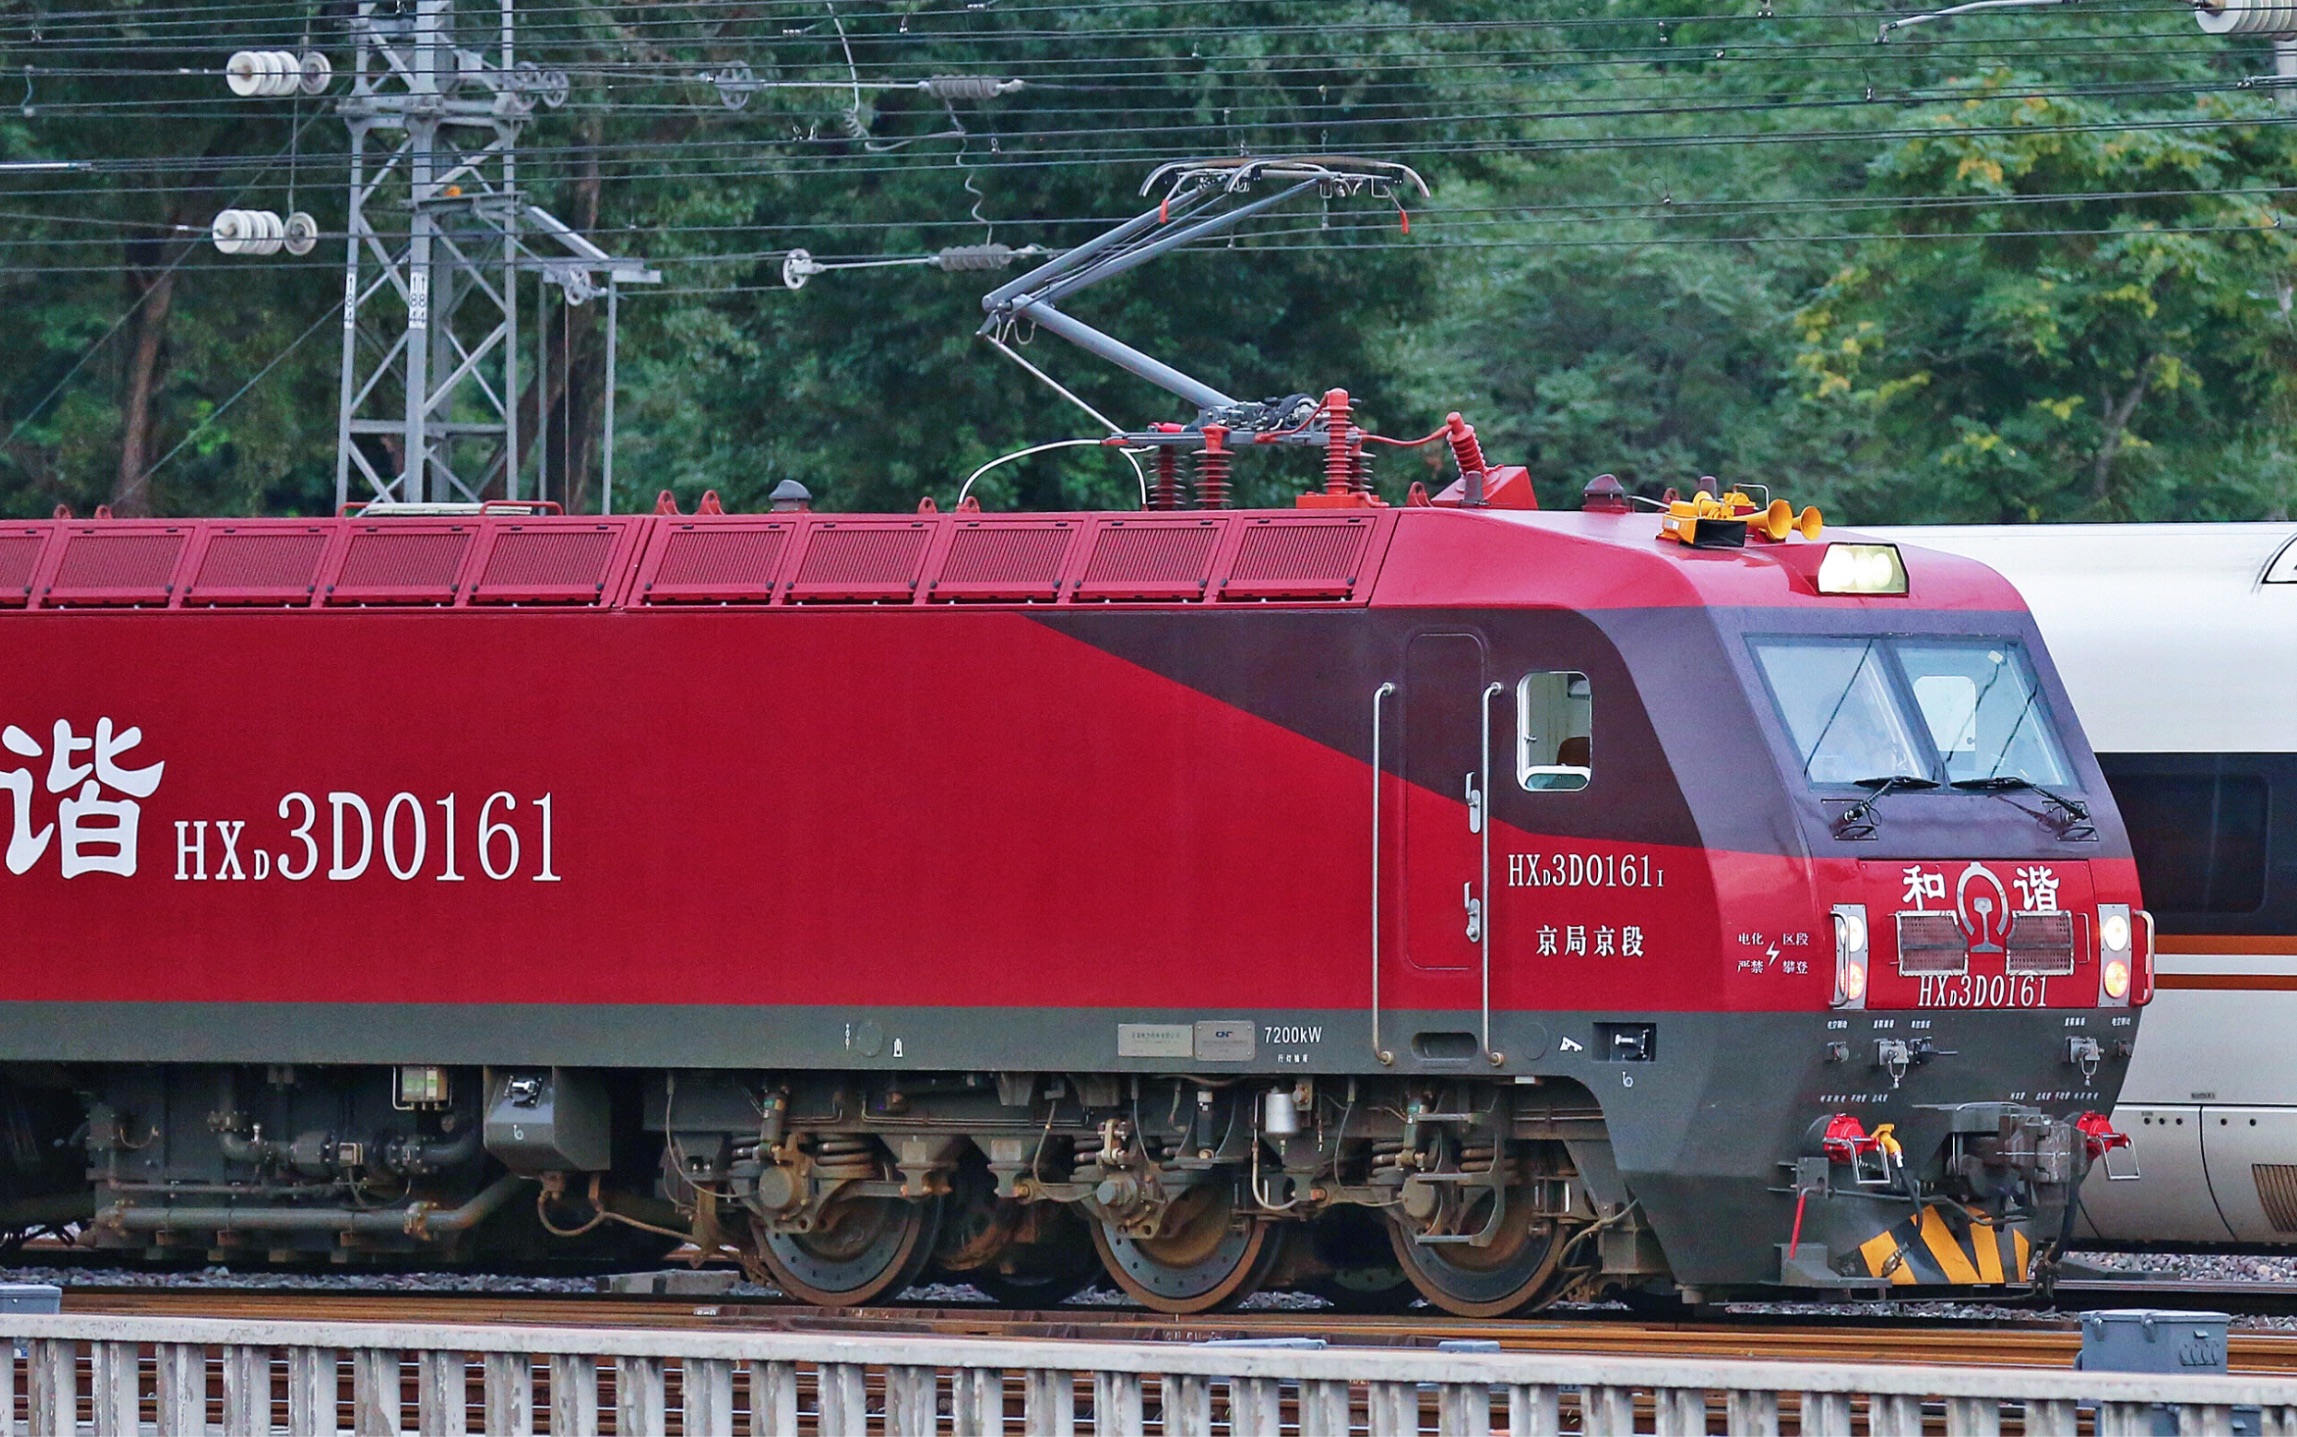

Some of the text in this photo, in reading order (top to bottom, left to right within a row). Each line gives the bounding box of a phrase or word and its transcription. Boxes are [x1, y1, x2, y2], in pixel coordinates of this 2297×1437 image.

[0, 716, 165, 880] 谐
[174, 791, 562, 882] HXD3D0161
[1902, 864, 2060, 911] 和 谐
[1536, 924, 1644, 957] 京局京段
[1738, 932, 1809, 946] 电化 区段
[1737, 960, 1809, 974] 严禁 攀登
[1918, 975, 2048, 1007] HXD3D0161
[1264, 1026, 1323, 1044] 7200kW
